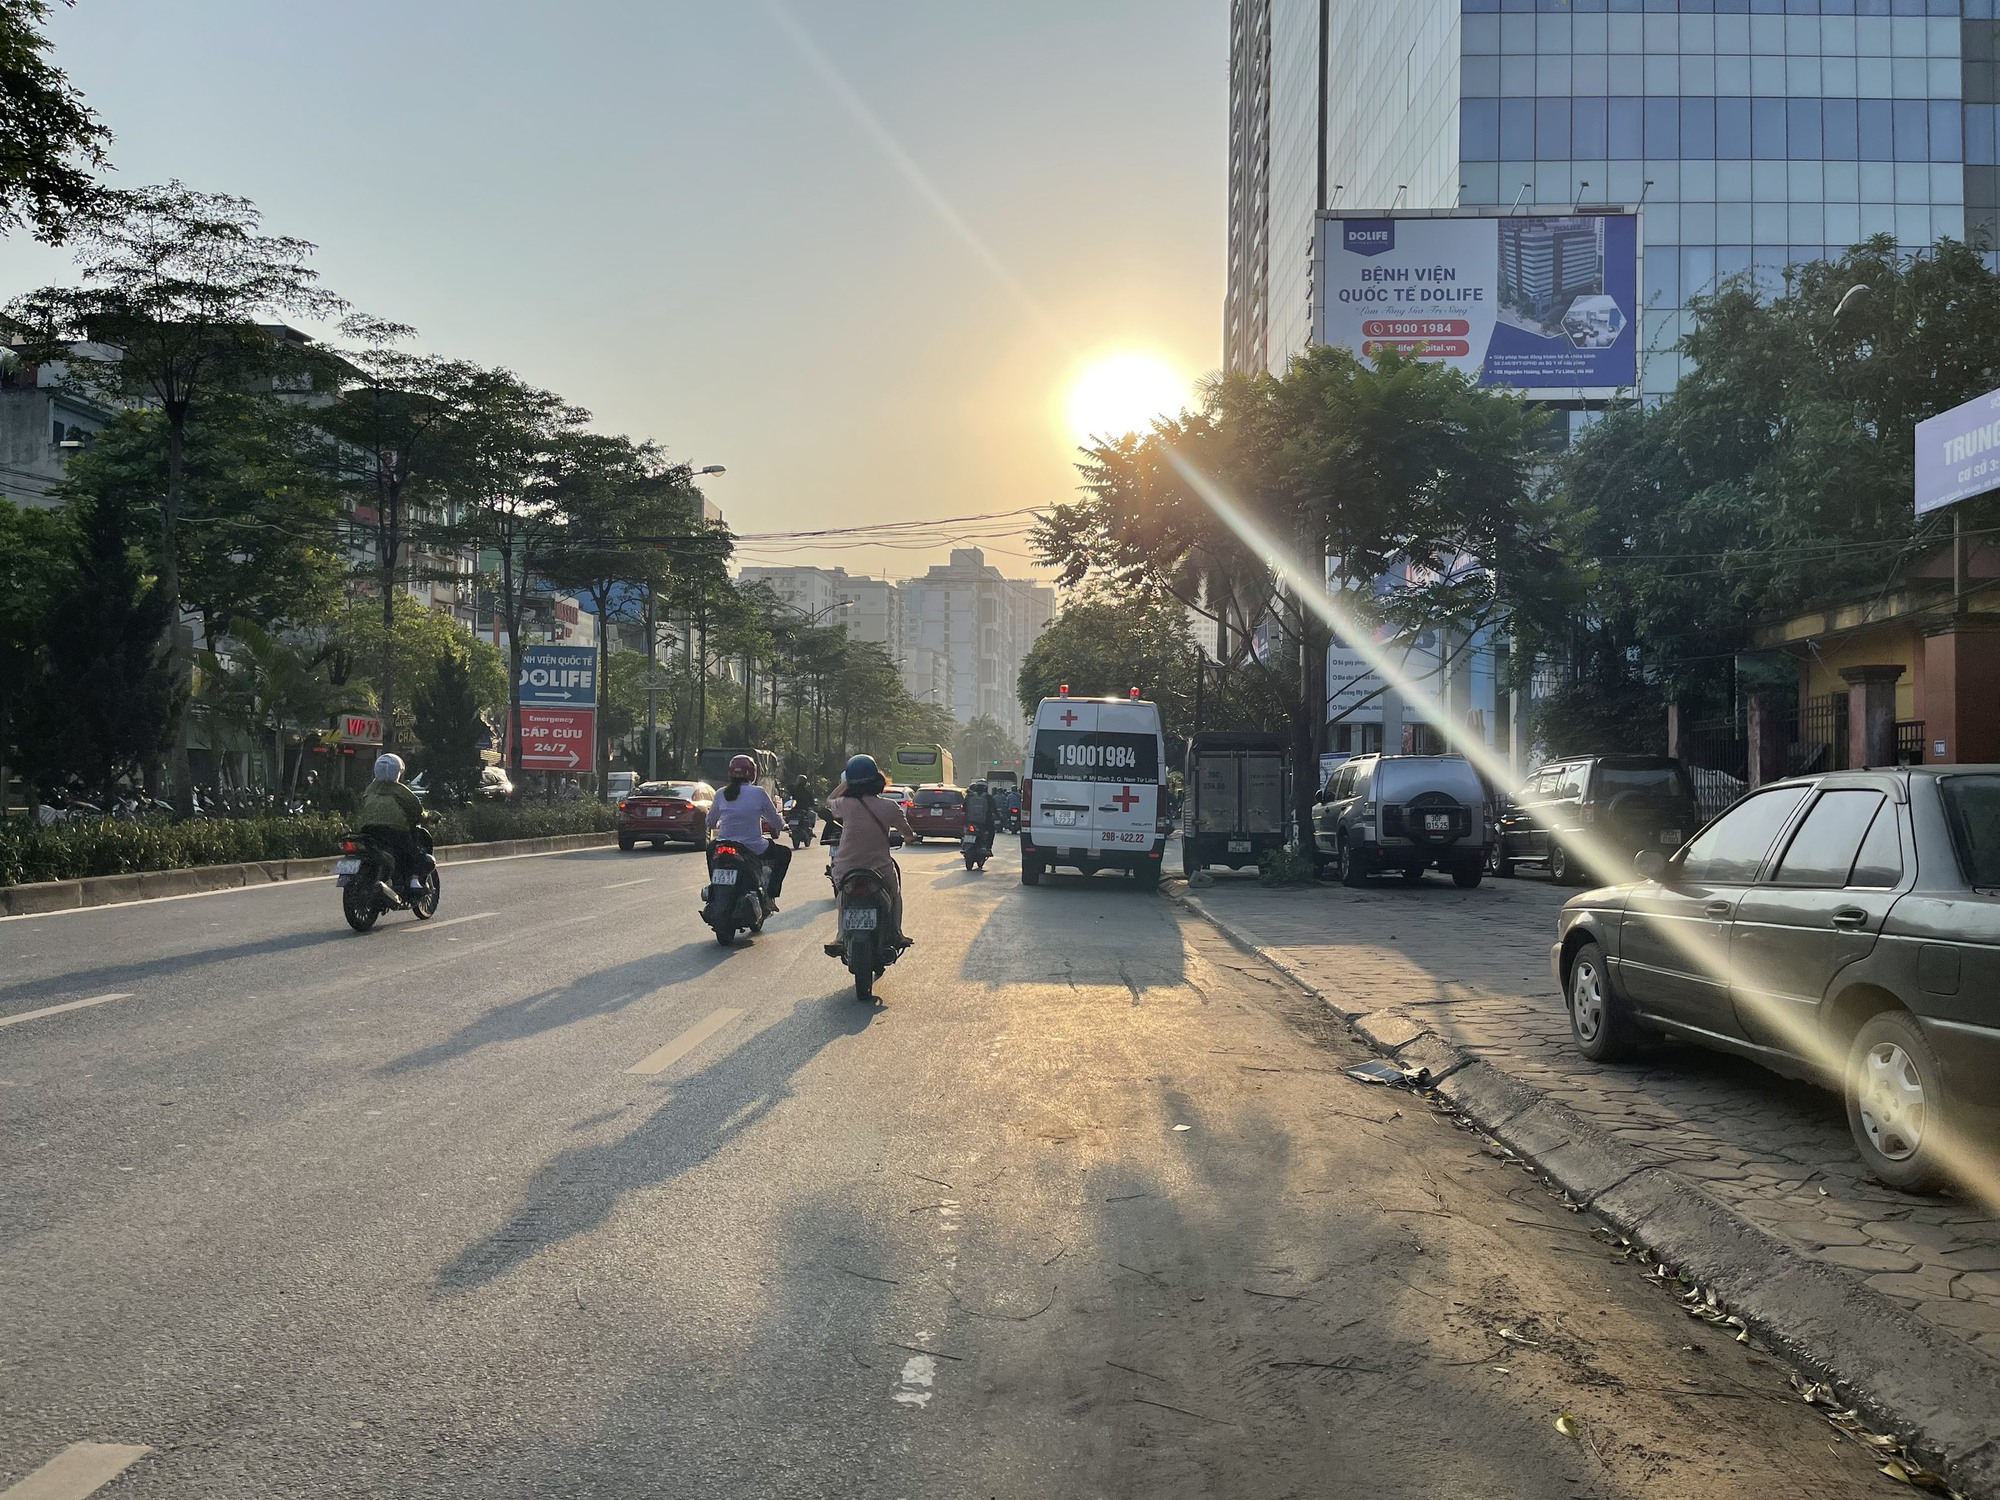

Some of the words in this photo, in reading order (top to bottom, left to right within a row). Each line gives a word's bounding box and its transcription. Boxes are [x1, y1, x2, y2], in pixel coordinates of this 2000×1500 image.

[1349, 231, 1388, 240] DOLIFE
[1361, 265, 1409, 284] BỆNH
[1414, 265, 1456, 284] VIỆN
[1339, 285, 1388, 303] QUỐC
[1393, 285, 1417, 301] TẾ
[1420, 288, 1483, 301] DOLIFE
[1387, 323, 1418, 334] 1900
[1421, 323, 1452, 333] 1984
[537, 655, 556, 665] VIỆN
[558, 654, 581, 665] QUỐC
[583, 655, 593, 666] TẾ
[529, 715, 574, 724] Emergency
[348, 718, 367, 736] VIP
[534, 743, 567, 752] 24/7
[1058, 744, 1136, 768] 19001984
